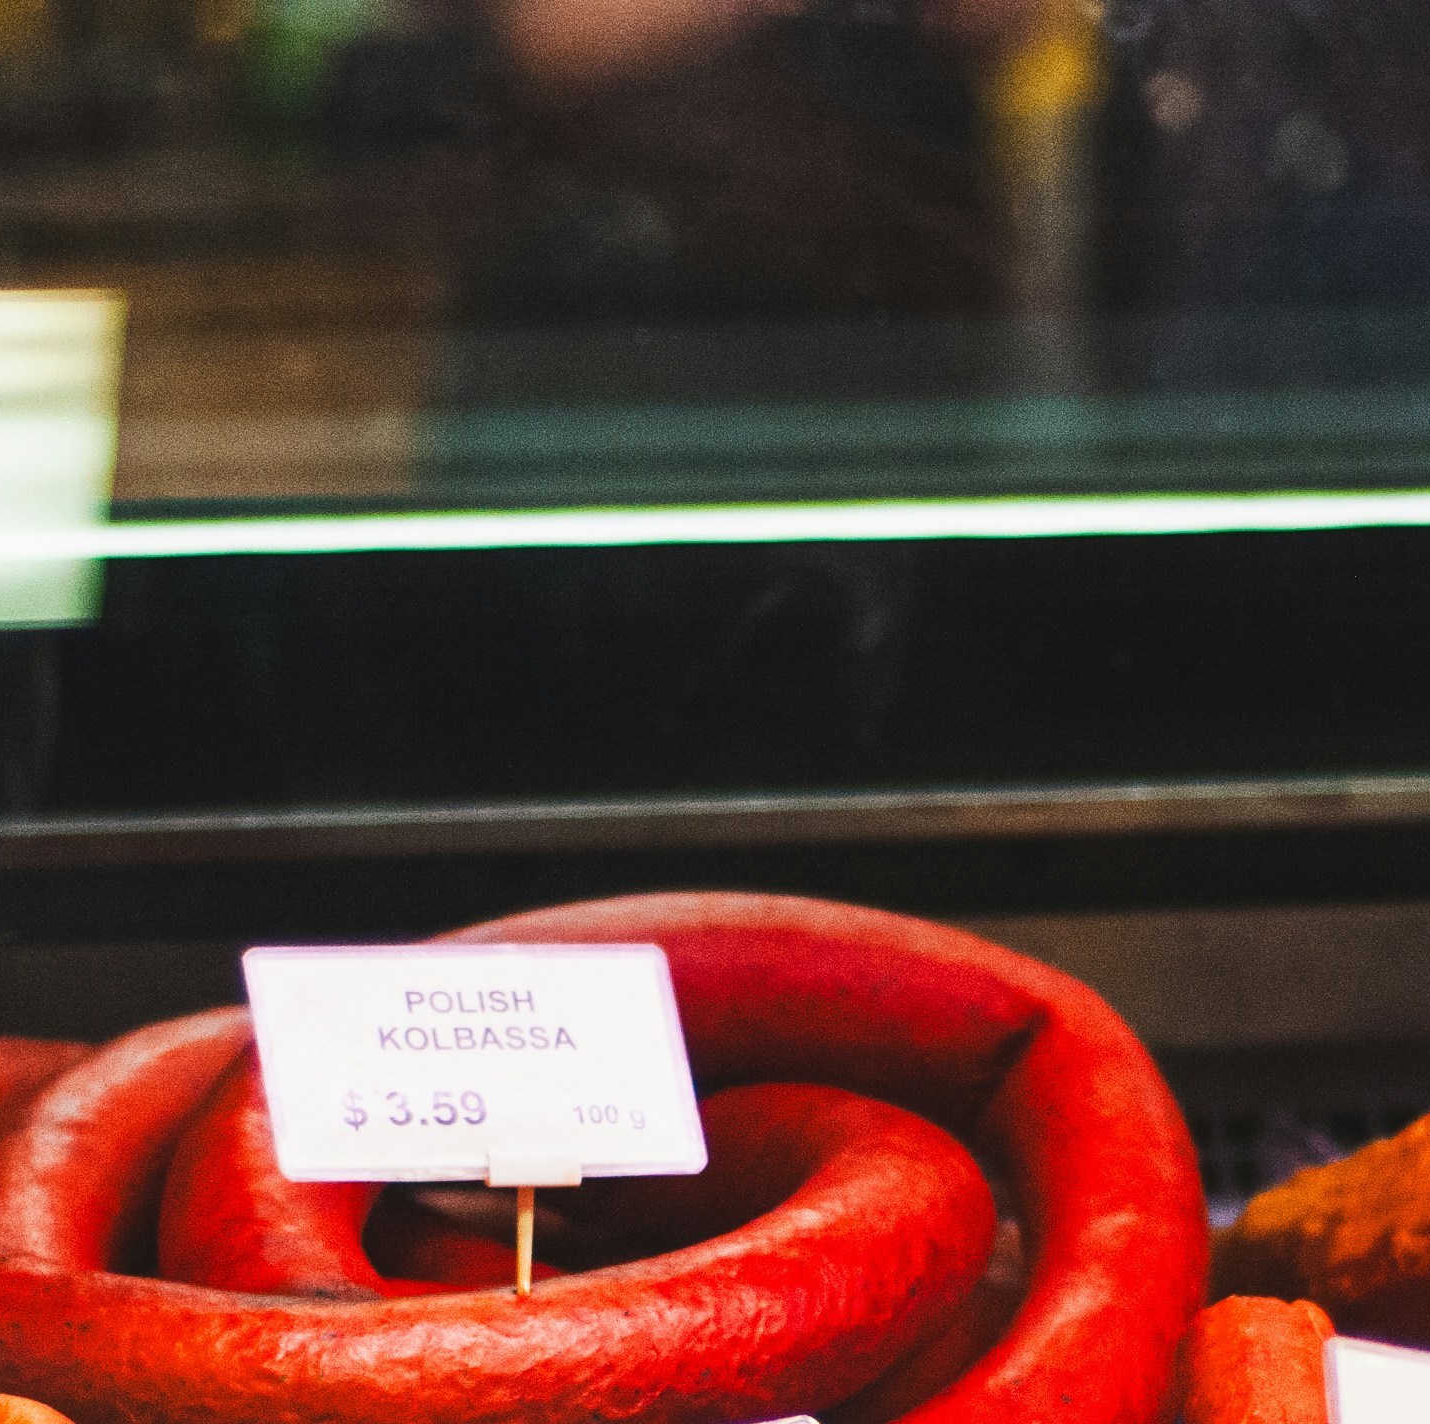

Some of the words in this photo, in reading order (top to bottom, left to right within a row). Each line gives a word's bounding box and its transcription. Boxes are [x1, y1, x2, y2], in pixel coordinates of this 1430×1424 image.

[403, 990, 536, 1014] POLISH
[378, 1026, 577, 1051] KOLBASSA
[342, 1090, 369, 1131] $
[386, 1091, 488, 1127] 3.59
[573, 1104, 620, 1126] 100
[630, 1108, 646, 1130] g
